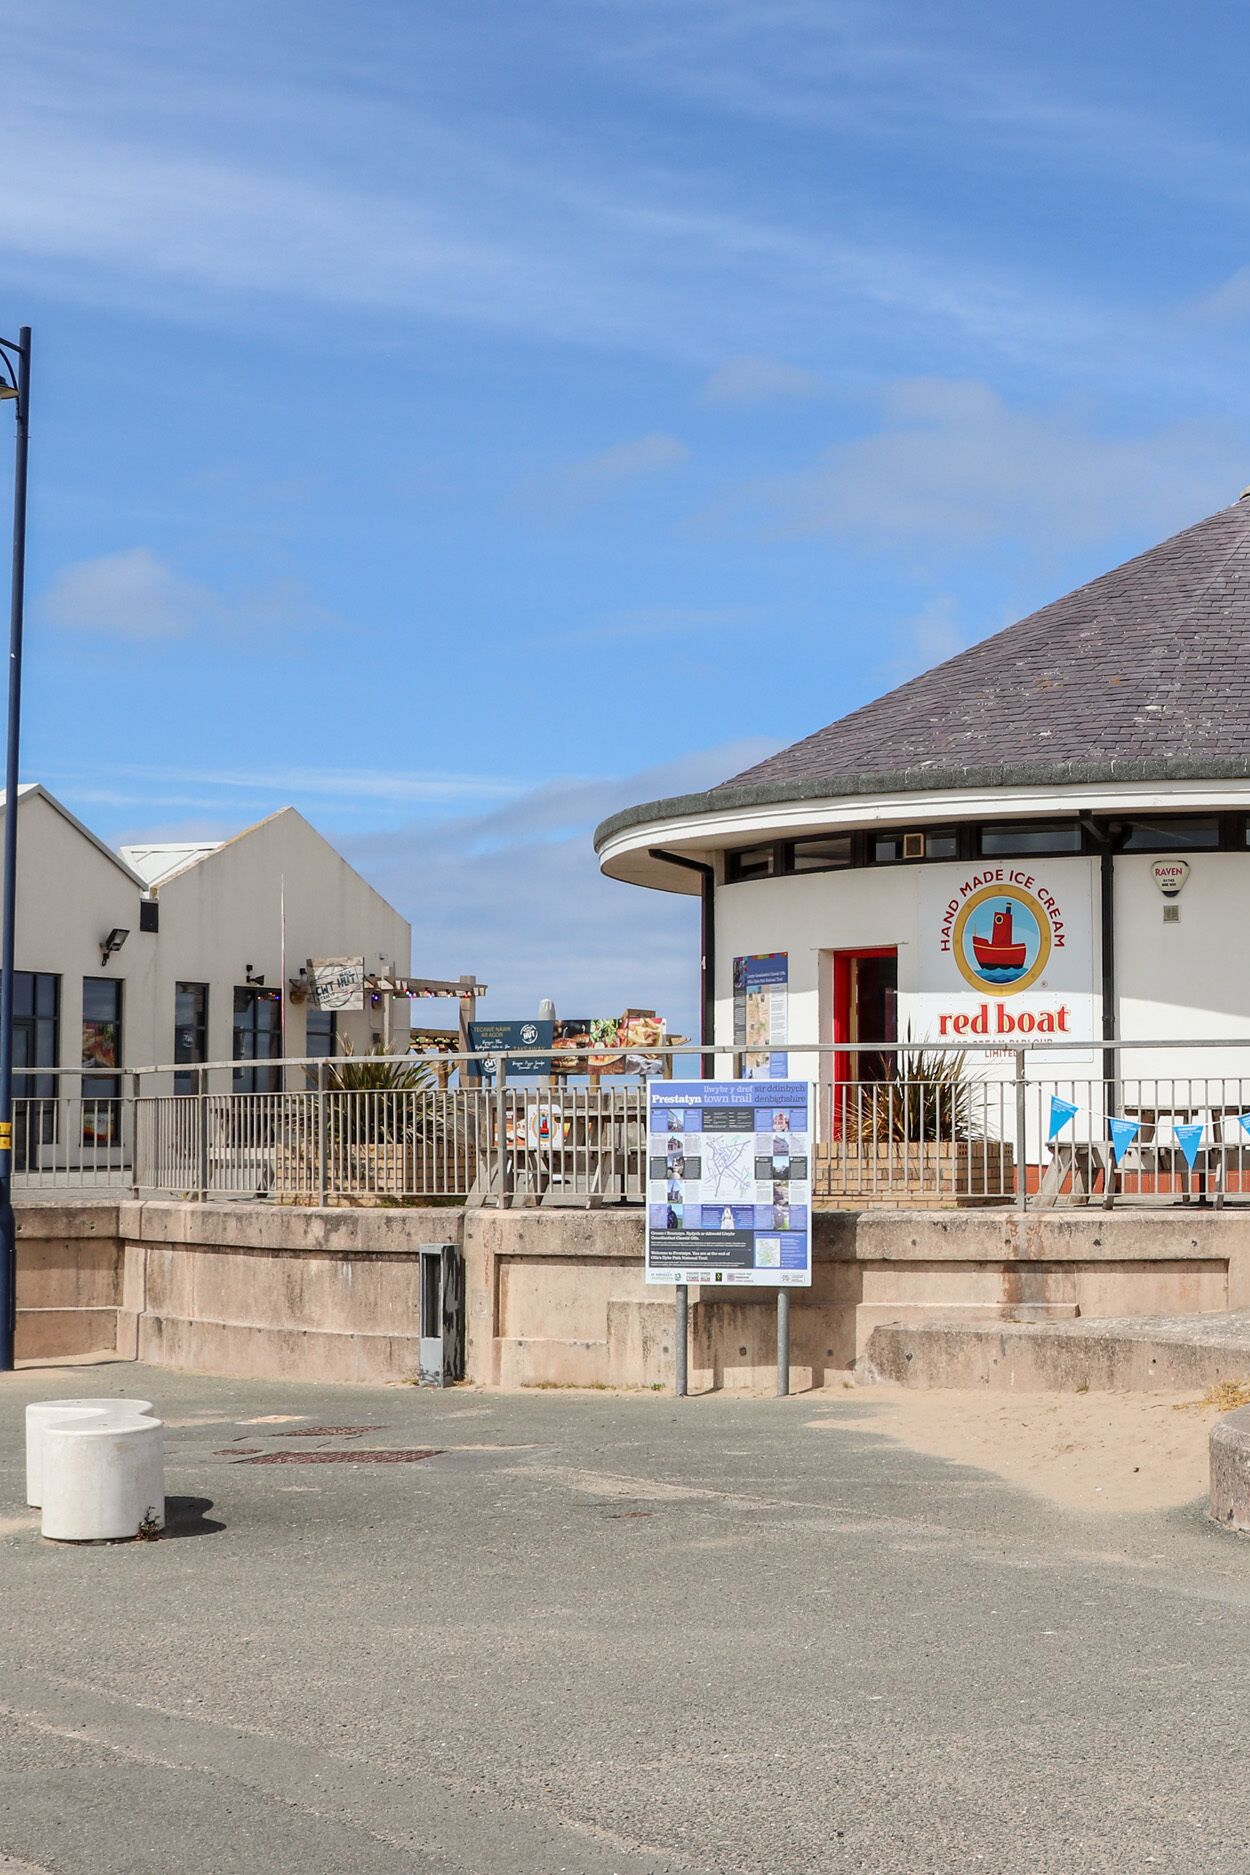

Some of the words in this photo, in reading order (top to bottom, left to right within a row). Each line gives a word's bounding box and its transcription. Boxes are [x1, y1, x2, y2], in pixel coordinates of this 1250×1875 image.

[1155, 867, 1183, 876] RAVEN
[941, 899, 959, 951] HAND
[959, 869, 1004, 898] MADE
[1009, 870, 1035, 889] ICE
[1037, 887, 1065, 948] CREAM
[337, 973, 355, 988] HUT
[938, 1004, 989, 1036] red
[996, 1003, 1071, 1035] boat
[652, 1094, 702, 1105] Prestatyn
[704, 1094, 729, 1103] town
[731, 1093, 753, 1103] trail
